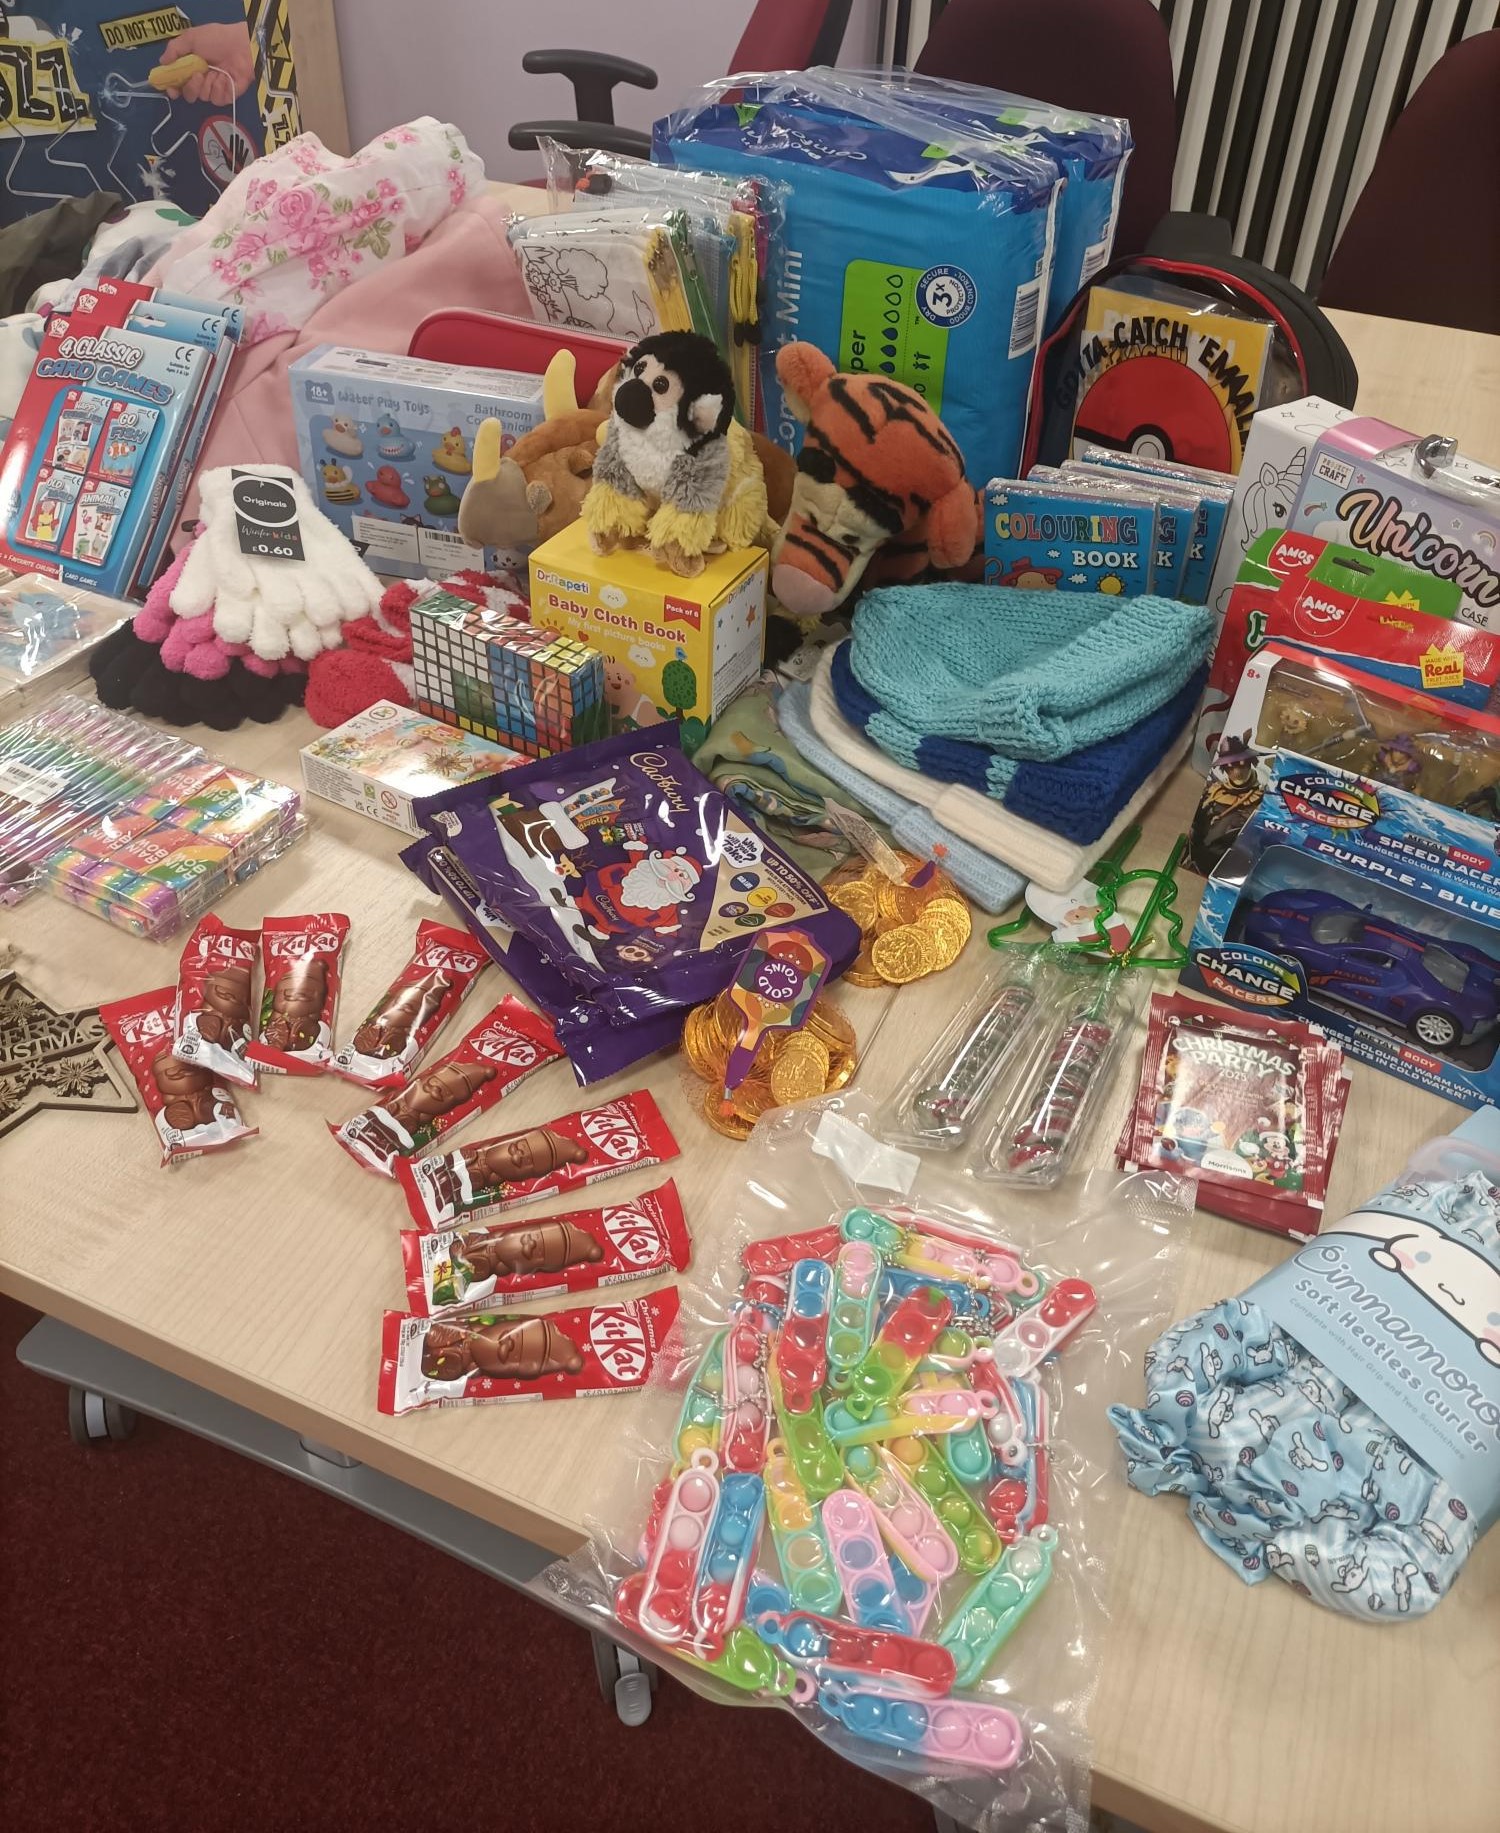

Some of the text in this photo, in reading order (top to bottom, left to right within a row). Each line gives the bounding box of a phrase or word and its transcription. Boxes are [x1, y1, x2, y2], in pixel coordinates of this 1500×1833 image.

[104, 26, 125, 46] DO
[124, 20, 148, 42] NOT
[920, 268, 949, 290] SECURE
[945, 279, 964, 315] PROTECTION
[921, 306, 936, 321] DRY
[949, 305, 972, 325] ODOUR
[1113, 316, 1190, 350] CATCH
[59, 337, 73, 358] 4
[74, 339, 143, 369] CLASSIC
[37, 358, 96, 381] CARD
[96, 365, 175, 405] GAMES
[310, 386, 328, 397] 18+
[337, 390, 431, 415] Water Play Toys
[474, 403, 533, 421] Bathroom
[119, 413, 137, 426] GO
[110, 426, 149, 443] FISH
[1319, 464, 1347, 484] CRAFT
[80, 493, 116, 506] ANIMAL
[242, 495, 288, 508] Originals
[271, 531, 298, 541] kids
[994, 512, 1139, 545] COLOURING
[1071, 550, 1139, 568] BOOK
[1275, 543, 1315, 566] AMOS
[1335, 488, 1500, 608] Unicorn
[64, 572, 79, 581] CARD
[547, 593, 688, 645] Baby Cloth Book
[665, 602, 683, 616] Pack
[683, 607, 693, 617] of
[1302, 595, 1345, 621] AMOS
[1461, 607, 1489, 627] CASE
[582, 617, 601, 634] first
[603, 625, 635, 646] picture
[637, 634, 666, 652] books
[1424, 660, 1461, 678] Real
[629, 751, 691, 815] Cadbury
[1304, 776, 1365, 797] COLOUR
[1280, 780, 1375, 823] CHANGE
[1295, 802, 1360, 827] RACERS
[734, 842, 749, 854] you
[741, 837, 758, 853] Who
[1379, 835, 1440, 865] SPEED
[766, 857, 778, 867] UP
[776, 864, 788, 875] TO
[1318, 841, 1417, 888] PURPLE
[1354, 838, 1485, 891] CHANGES COLOUR IN WARM
[1453, 851, 1486, 867] BODY
[271, 932, 339, 956] KitKat
[413, 946, 478, 972] KitKat
[1220, 951, 1285, 976] COLOUR
[764, 962, 798, 985] COINS
[1196, 952, 1297, 1001] CHANGE
[758, 975, 794, 1000] GOLD
[1212, 976, 1279, 1004] RACERS
[0, 1011, 79, 1049] ERRY
[125, 1004, 176, 1042] KitK
[0, 1023, 107, 1063] ISTMAS
[469, 1034, 536, 1066] KitKat
[1172, 1036, 1297, 1076] CHRISTMAS
[1189, 1050, 1275, 1079] PARTY
[1403, 1050, 1436, 1068] BODY
[1353, 1039, 1400, 1065] COLOUR
[1400, 1060, 1413, 1070] IN
[1414, 1065, 1453, 1087] WARM
[1453, 1083, 1496, 1106] WATER
[1375, 1055, 1388, 1067] IN
[1389, 1061, 1421, 1081] COLD
[1420, 1076, 1467, 1101] WATER!
[581, 1109, 638, 1160] KitKat
[1207, 1159, 1247, 1174] Morrisons
[602, 1202, 660, 1262] KitKat
[638, 1299, 657, 1349] Christmas
[590, 1305, 646, 1377] KitKat
[1289, 1297, 1329, 1331] Complete
[1328, 1328, 1348, 1347] with
[1366, 1361, 1384, 1382] Grip
[1384, 1379, 1403, 1397] and
[1402, 1396, 1419, 1414] Two
[1418, 1410, 1466, 1460] Scrunchies
[1295, 1278, 1488, 1453] Soft Heatless Curler
